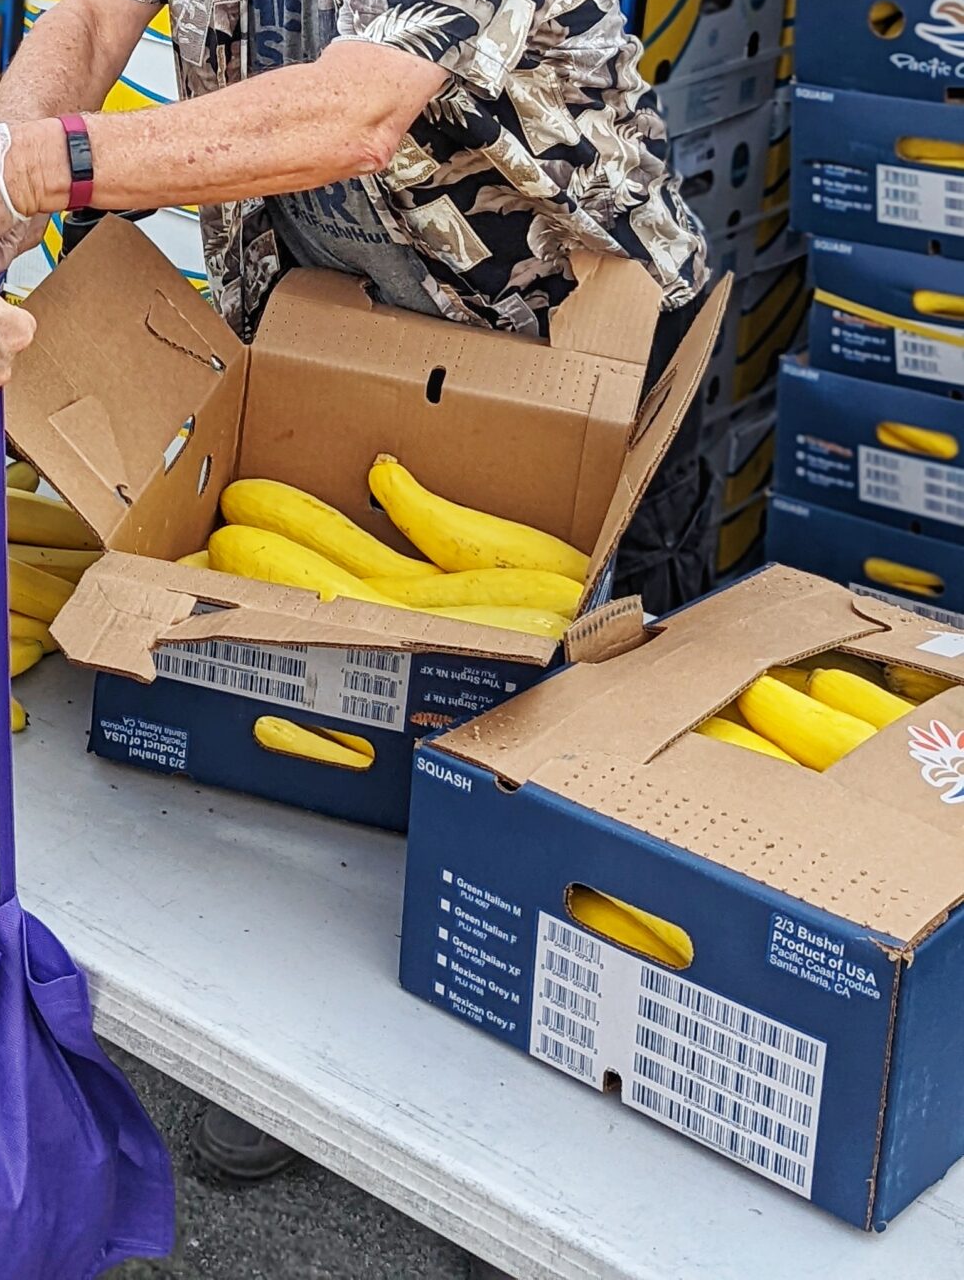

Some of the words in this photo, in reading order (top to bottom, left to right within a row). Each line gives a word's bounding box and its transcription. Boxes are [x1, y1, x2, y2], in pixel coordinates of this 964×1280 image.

[795, 87, 835, 103] SQUASH
[814, 239, 853, 255] SQUASH
[419, 665, 434, 676] XF
[435, 667, 449, 679] Nk
[451, 670, 481, 685] Strght
[482, 678, 501, 690] Ylw
[423, 693, 431, 701] F
[432, 693, 447, 704] Nk
[447, 696, 478, 711] Strght
[100, 720, 133, 735] Produce
[122, 716, 136, 727] CA
[137, 720, 163, 734] Maria,
[103, 729, 127, 745] USA
[129, 736, 141, 746] of
[135, 728, 159, 741] Coast
[164, 728, 188, 740] Santa
[143, 740, 186, 758] Product
[159, 736, 187, 748] Pacific
[128, 747, 167, 765] Bushel
[168, 756, 186, 770] 2/3
[416, 757, 473, 793] SQUASH
[456, 877, 483, 898] Green
[484, 890, 512, 913] Italian
[512, 905, 522, 918] M
[460, 889, 474, 902] PLU
[454, 906, 481, 927] Green
[482, 920, 509, 942] Italian
[510, 934, 518, 944] F
[458, 920, 472, 933] PLU
[774, 915, 795, 934] 2/3
[797, 925, 845, 958] Bushel
[452, 936, 478, 956] Green
[480, 949, 507, 971] Italian
[508, 964, 522, 977] XF
[456, 947, 470, 959] PLU
[772, 930, 827, 965] Product
[827, 957, 844, 971] of
[845, 962, 878, 988] USA
[769, 954, 799, 975] Santa
[800, 967, 832, 992] Maria,
[834, 982, 852, 999] CA
[771, 943, 804, 966] Pacific
[805, 959, 836, 981] Coast
[837, 972, 881, 1000] Produce
[451, 960, 487, 986] Mexican
[488, 981, 510, 1000] Grey
[511, 992, 520, 1005] M
[454, 975, 468, 988] PLU
[448, 990, 485, 1016] Mexican
[486, 1010, 508, 1030] Grey
[509, 1022, 517, 1031] F
[452, 1002, 467, 1015] PLU
